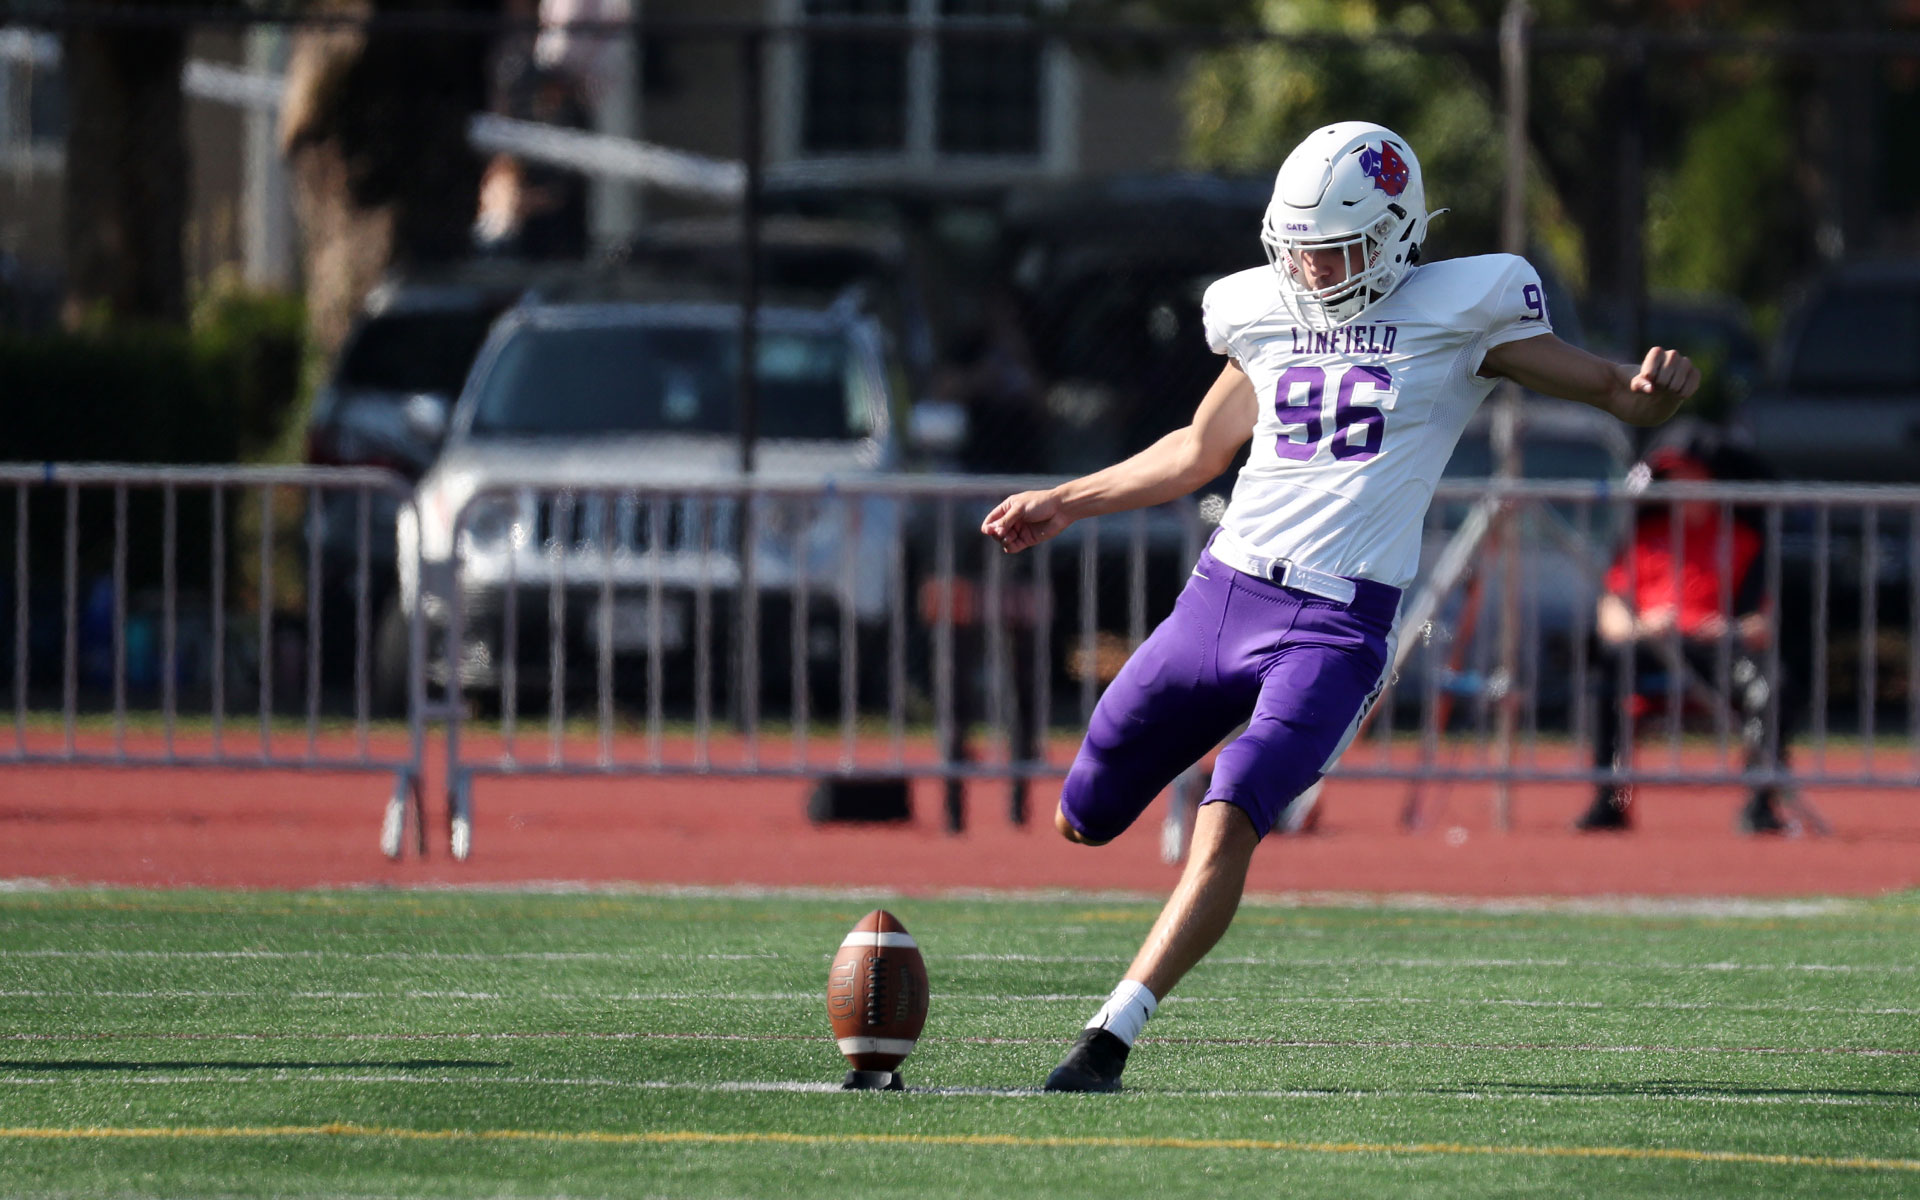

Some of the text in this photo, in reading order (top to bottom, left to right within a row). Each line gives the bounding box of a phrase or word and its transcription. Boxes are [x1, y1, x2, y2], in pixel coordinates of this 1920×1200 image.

[1286, 223, 1308, 231] CATS
[1520, 283, 1551, 322] 9
[1291, 325, 1398, 355] LINFIELD
[1274, 366, 1395, 462] 96
